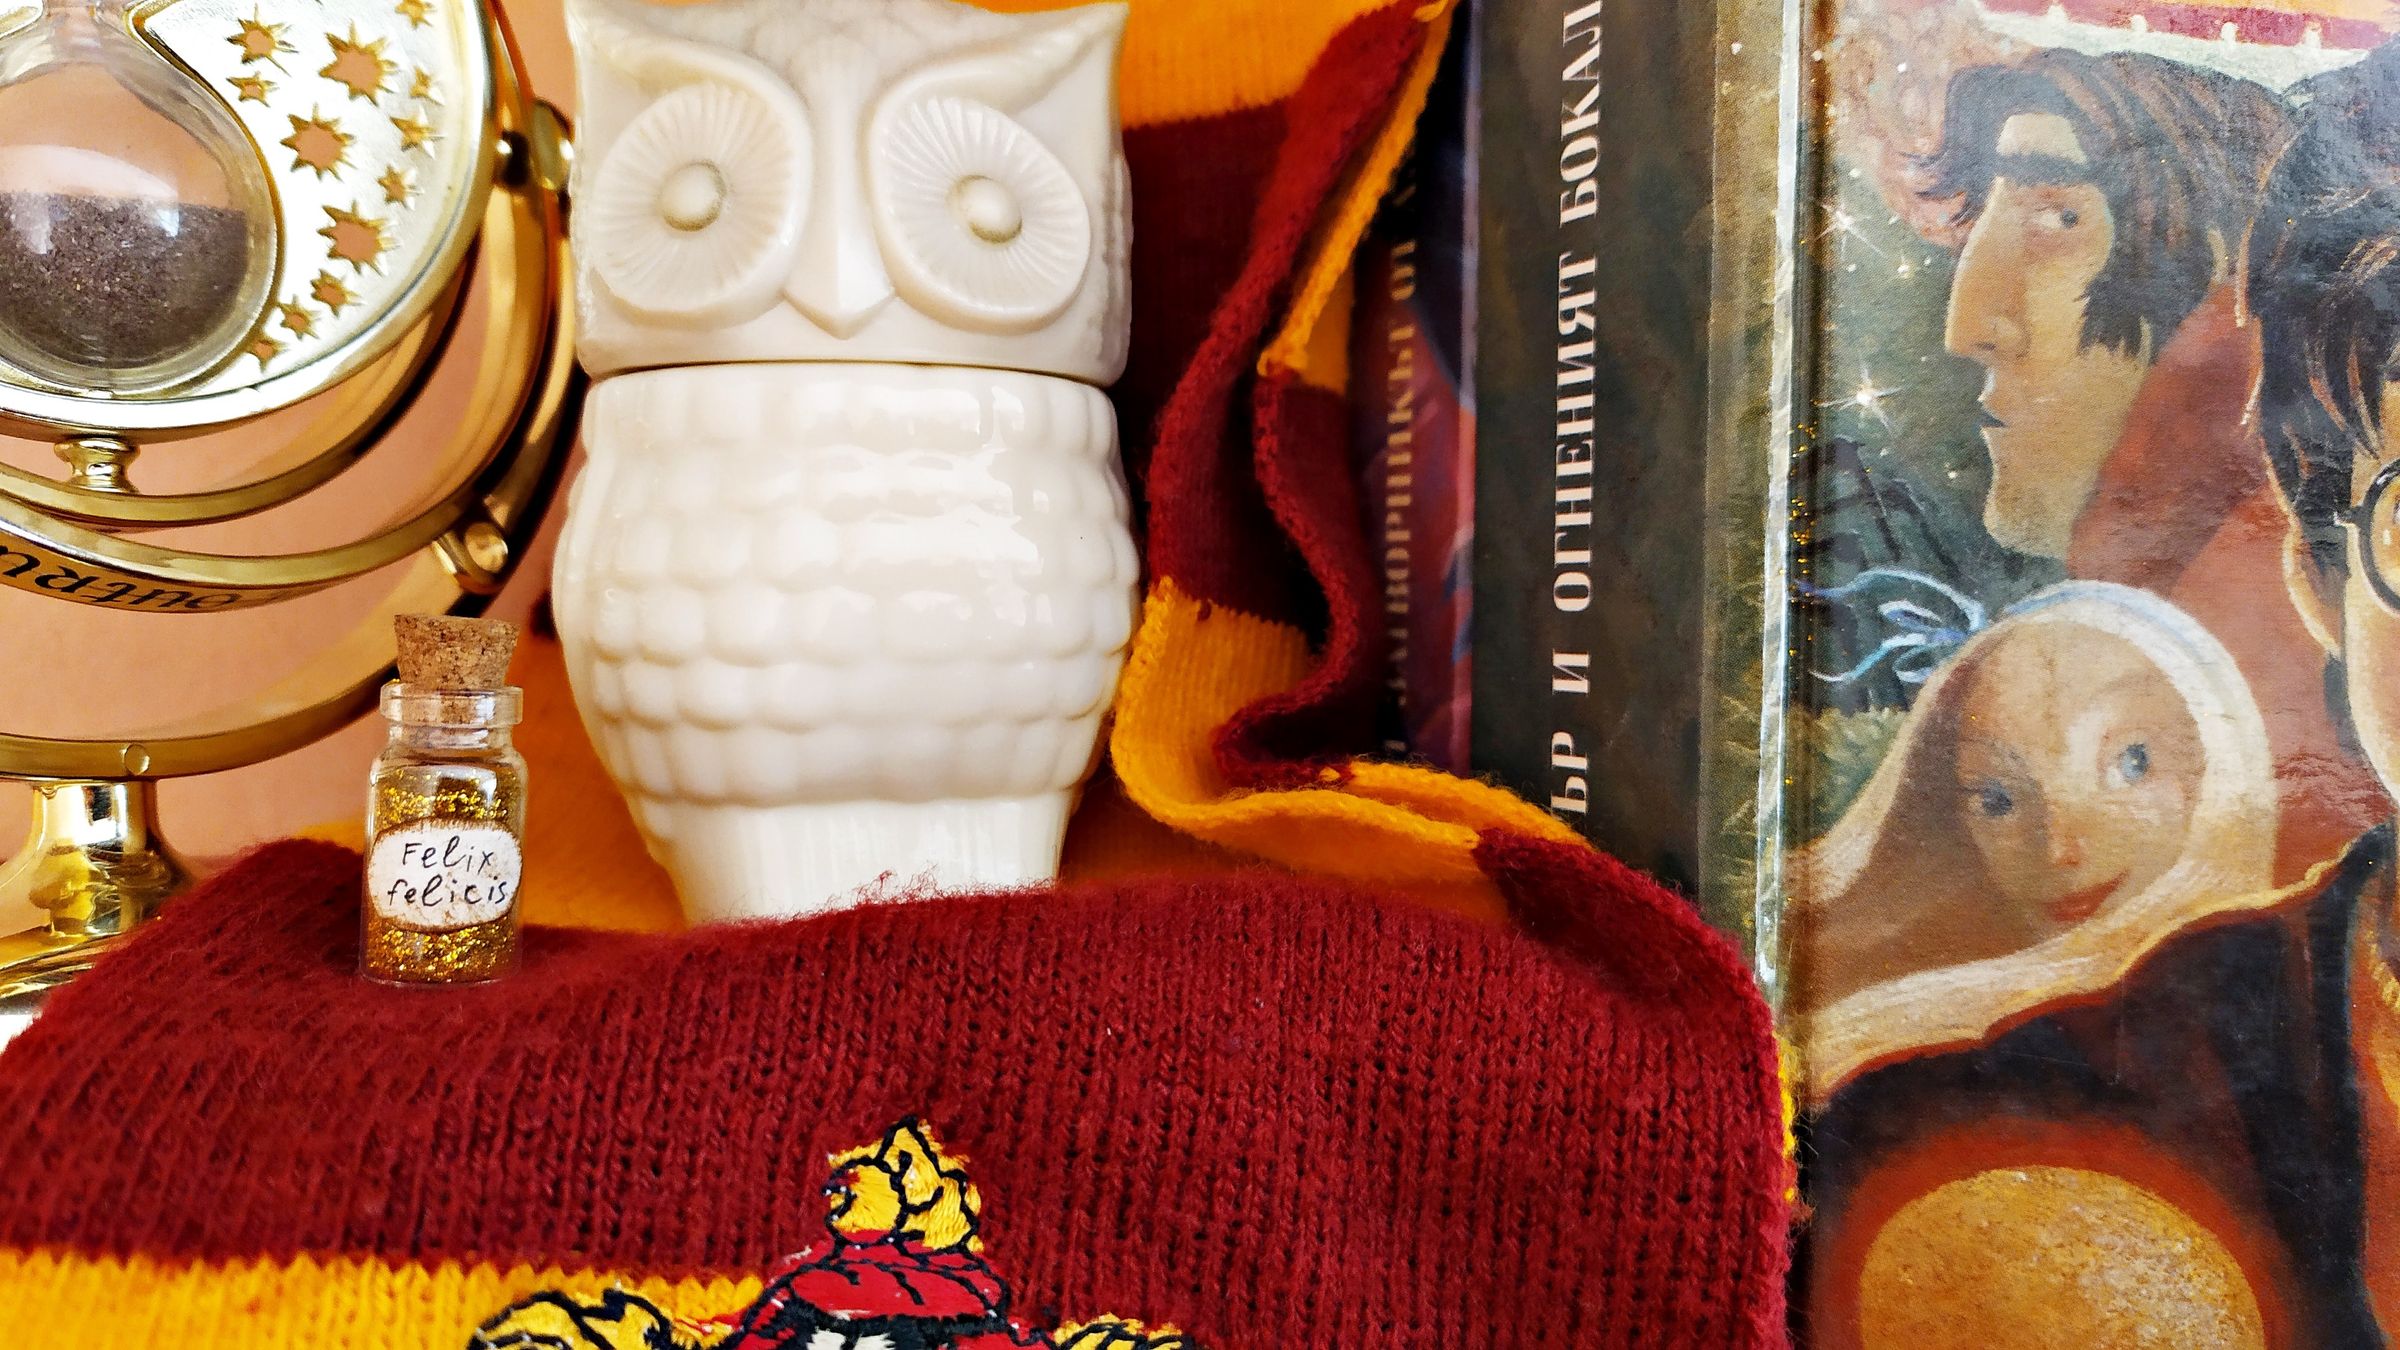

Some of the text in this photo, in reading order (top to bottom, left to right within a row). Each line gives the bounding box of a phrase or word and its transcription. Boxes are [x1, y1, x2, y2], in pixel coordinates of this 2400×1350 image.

[1559, 0, 1600, 228] БОКАЛ
[1553, 251, 1597, 612] ОГНЕНИЯТ
[1552, 649, 1590, 696] И
[402, 835, 495, 875] Felix
[387, 874, 507, 907] felicis
